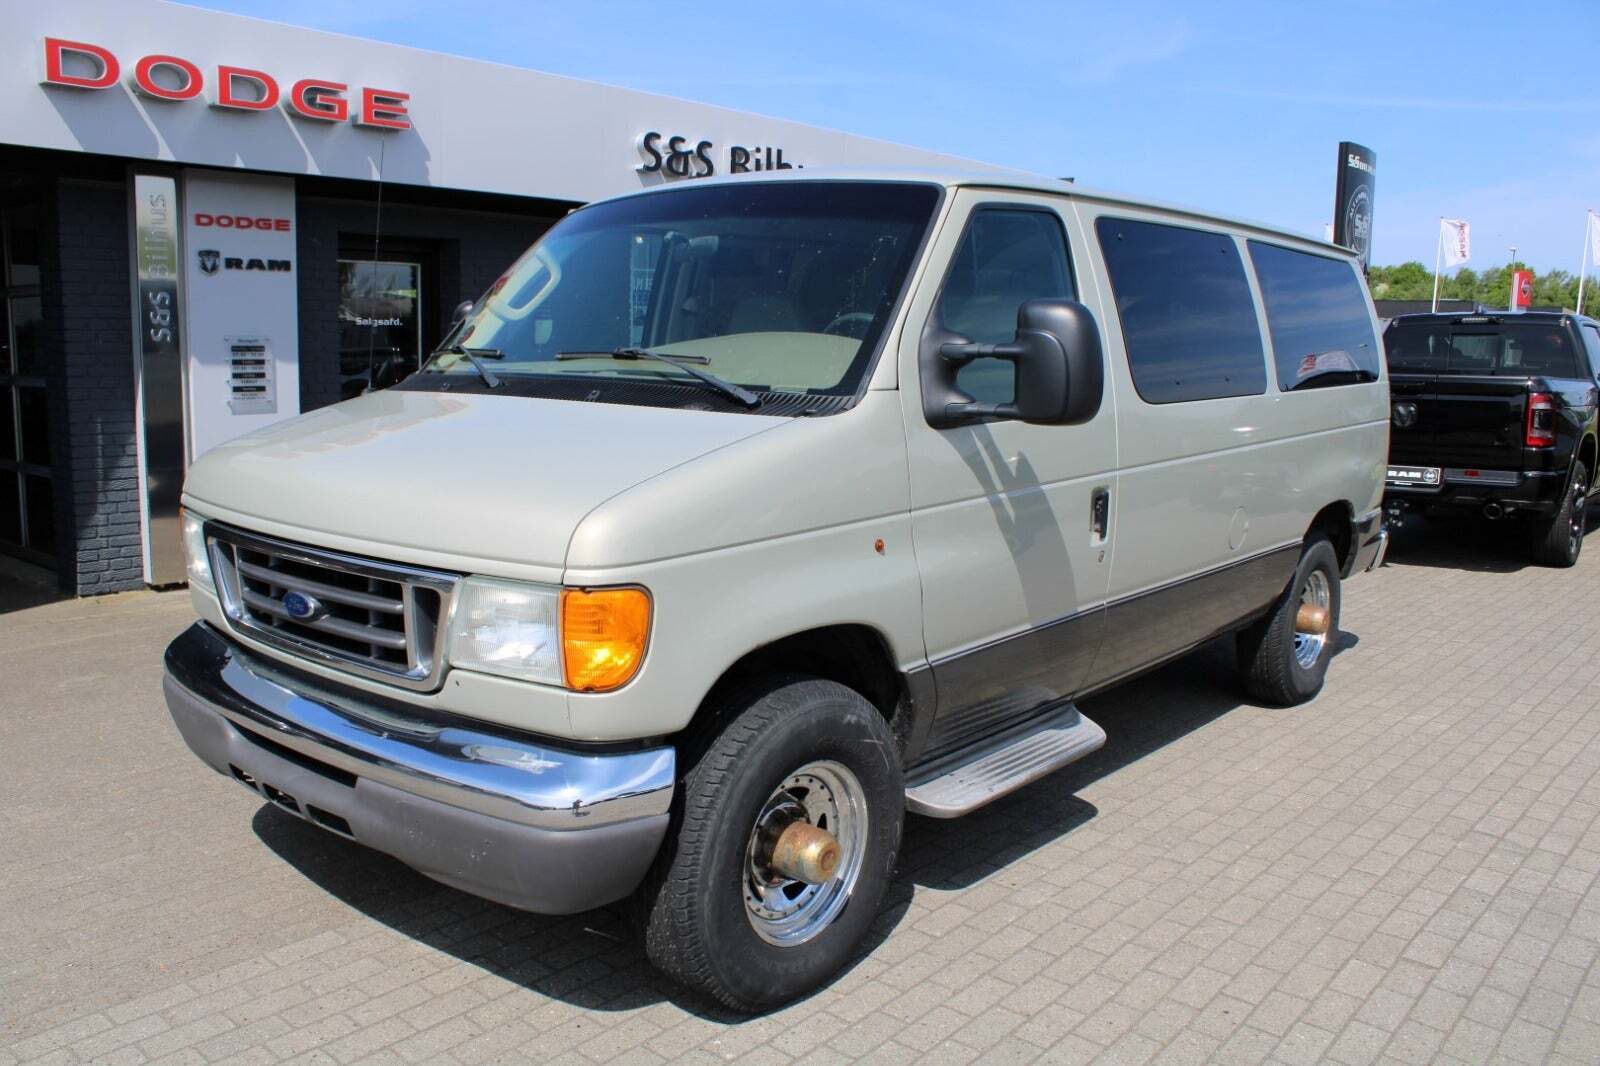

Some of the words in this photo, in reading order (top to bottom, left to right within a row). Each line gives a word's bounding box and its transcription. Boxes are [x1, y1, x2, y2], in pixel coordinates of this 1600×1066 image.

[44, 37, 411, 130] DODGE
[643, 131, 714, 178] S&S
[730, 146, 804, 174] Bilh
[194, 213, 291, 231] DODGE
[224, 257, 291, 272] RAM
[1387, 470, 1421, 478] RAM
